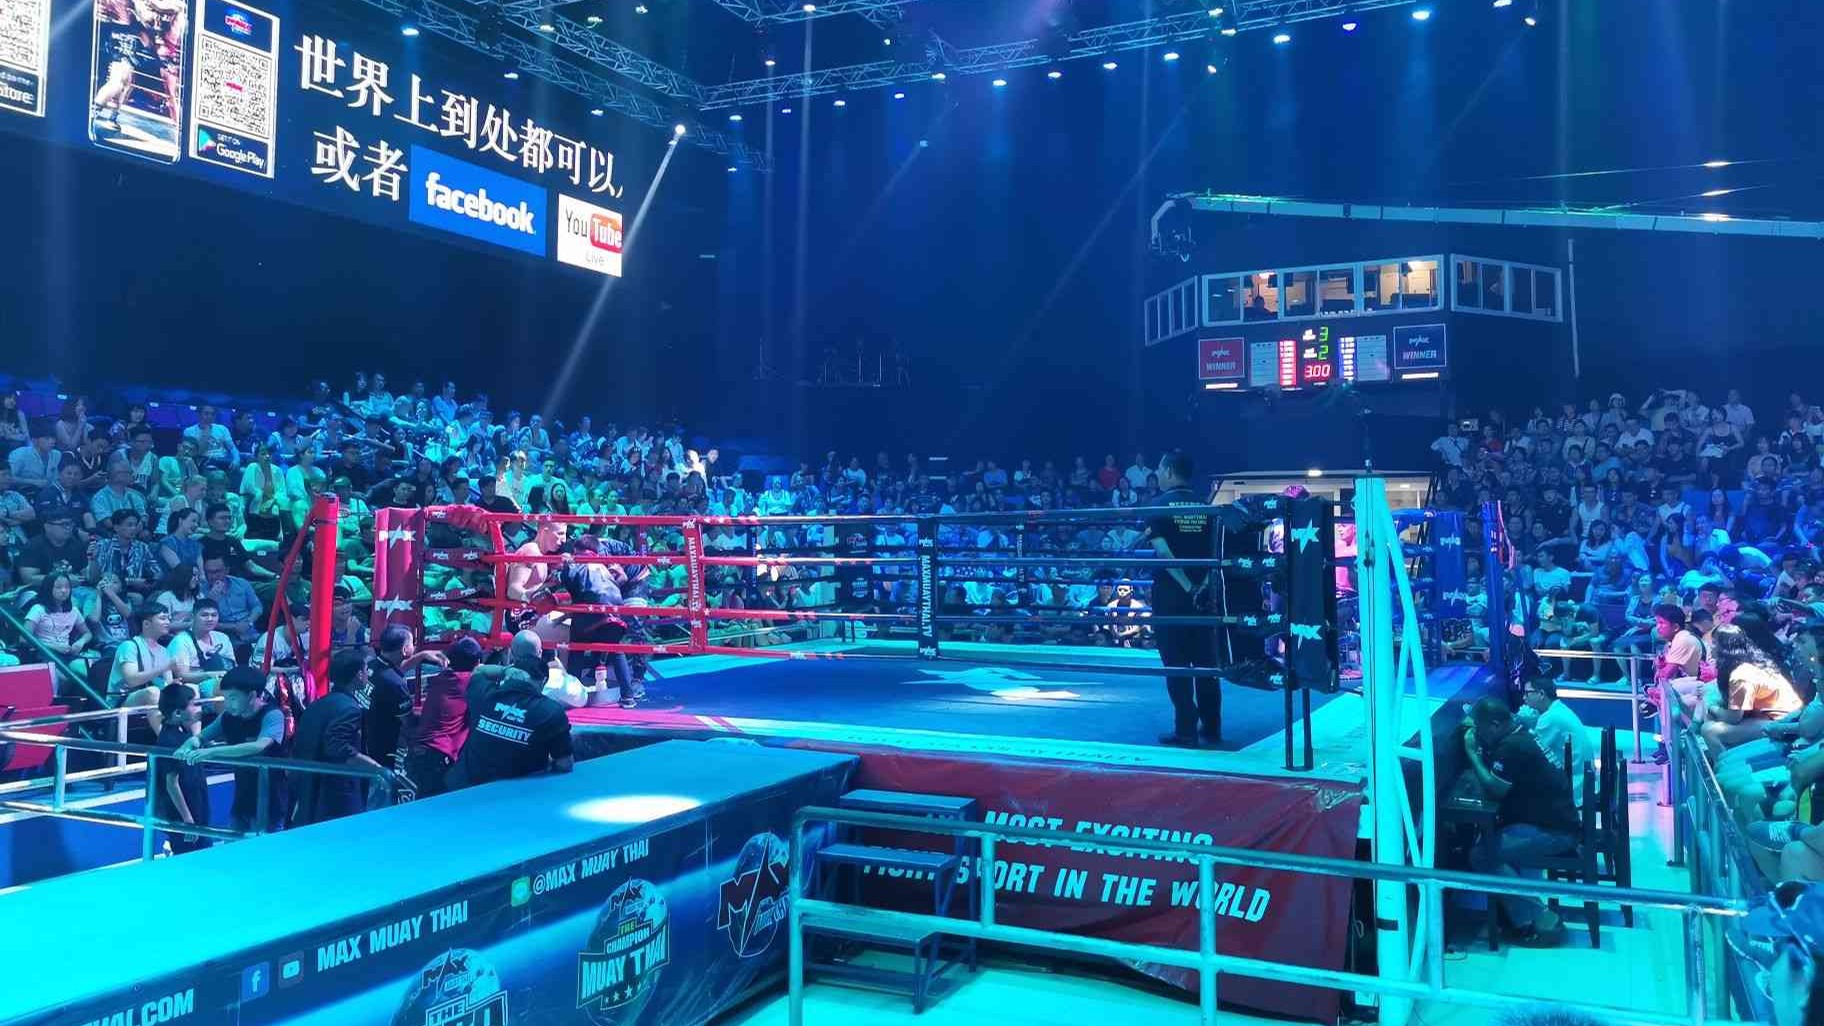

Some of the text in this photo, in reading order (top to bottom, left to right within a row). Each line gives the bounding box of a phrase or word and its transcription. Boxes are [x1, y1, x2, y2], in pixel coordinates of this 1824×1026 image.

[216, 143, 265, 169] Google Play
[311, 125, 409, 201] 或者
[425, 171, 536, 235] facebook
[1318, 344, 1329, 360] 2
[1319, 326, 1329, 342] 3
[1402, 349, 1437, 360] WINNER
[921, 554, 933, 638] MAXMUAYTHAI.TV
[477, 718, 533, 742] SECURITY
[532, 838, 649, 895] @MAX MUAY THAI
[956, 855, 1046, 894] SORT
[1053, 867, 1089, 900] IN
[1100, 872, 1157, 907] THE
[316, 899, 468, 973] MAX MUAY THAI
[606, 926, 650, 954] CHAMPION
[620, 922, 635, 935] THE
[581, 954, 626, 1000] MUAY
